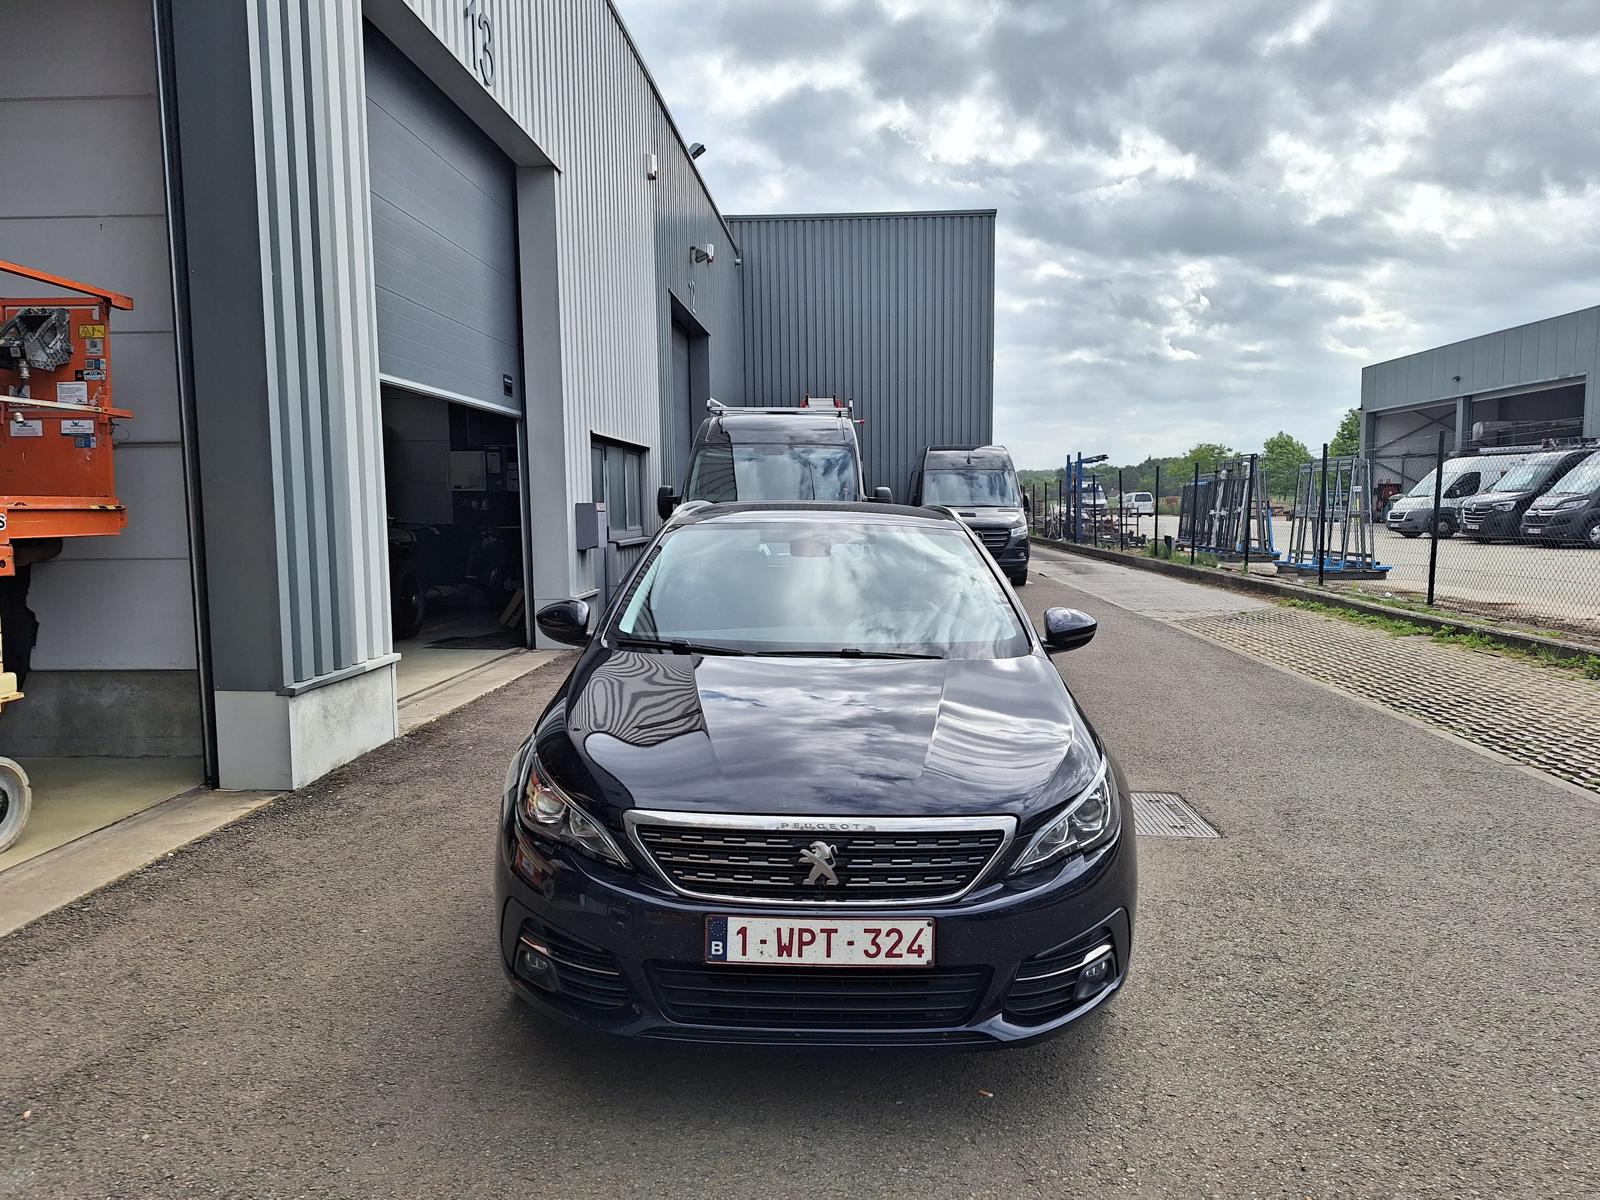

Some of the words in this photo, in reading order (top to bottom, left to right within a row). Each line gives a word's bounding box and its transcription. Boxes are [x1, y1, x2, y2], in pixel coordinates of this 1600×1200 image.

[464, 0, 495, 87] 13
[780, 822, 860, 831] PEUGEOT
[711, 940, 724, 956] B
[736, 926, 925, 959] 1-WPT-324
